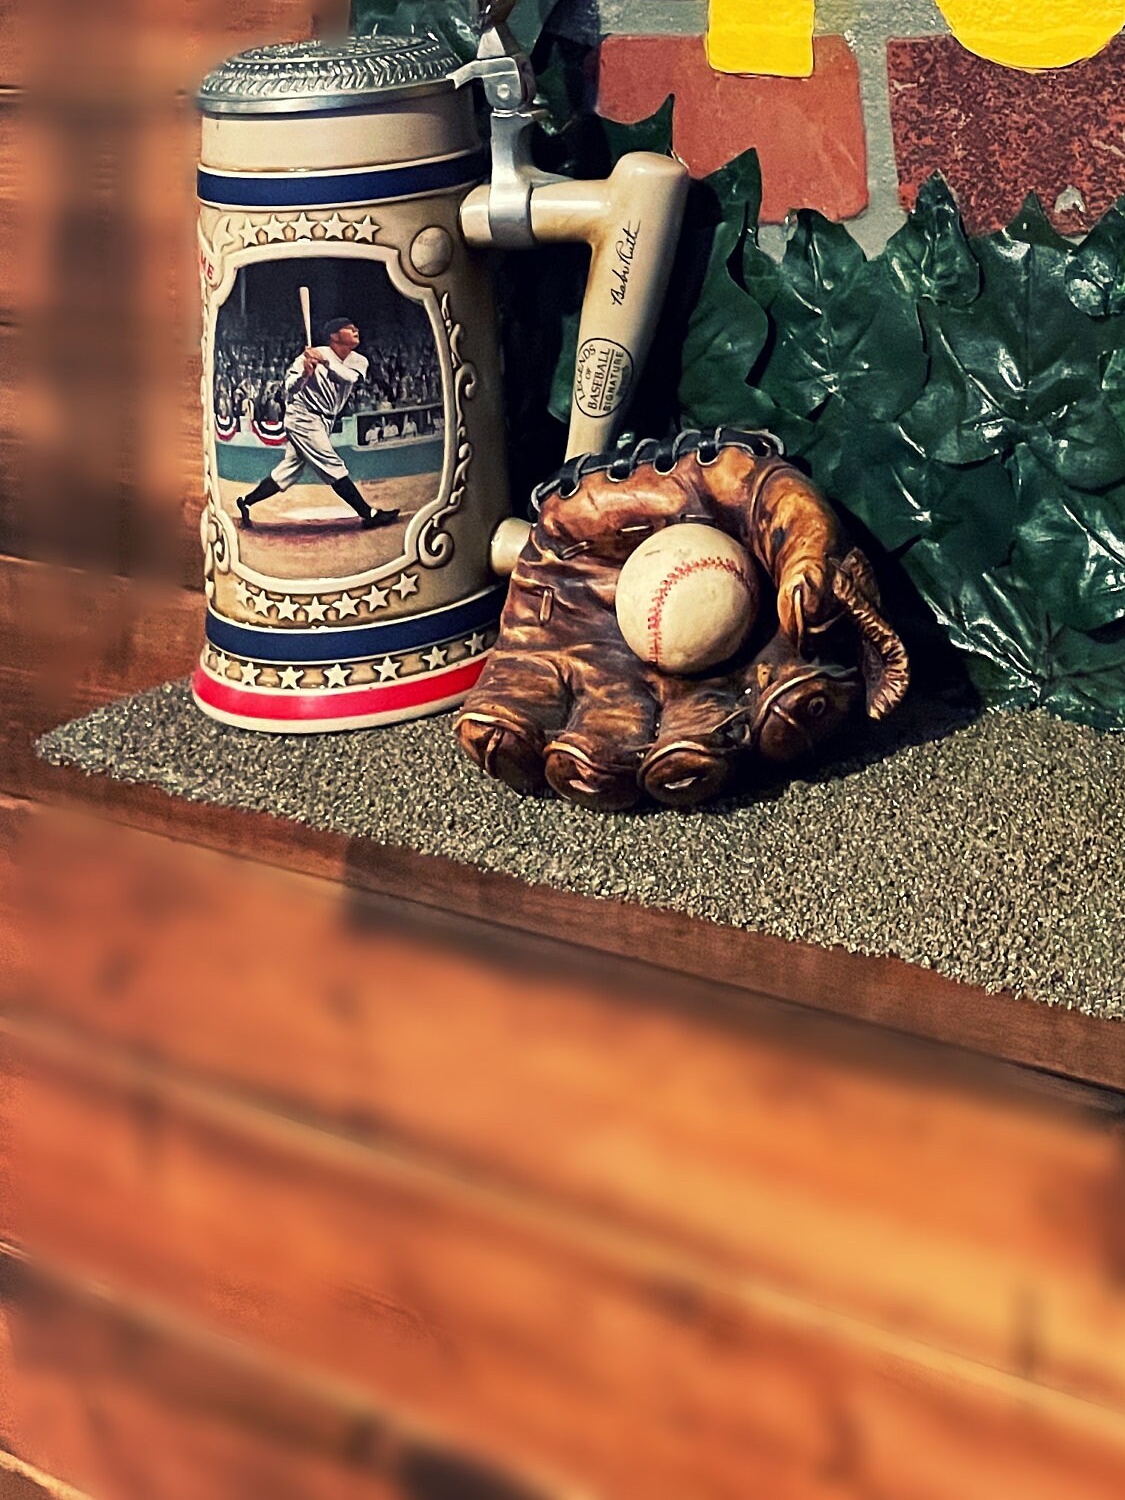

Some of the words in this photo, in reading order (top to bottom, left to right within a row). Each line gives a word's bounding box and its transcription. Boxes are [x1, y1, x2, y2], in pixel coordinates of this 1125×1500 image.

[576, 344, 596, 400] LEGENDS
[587, 348, 611, 410] BASEBALL
[602, 351, 625, 412] SIGNATURE
